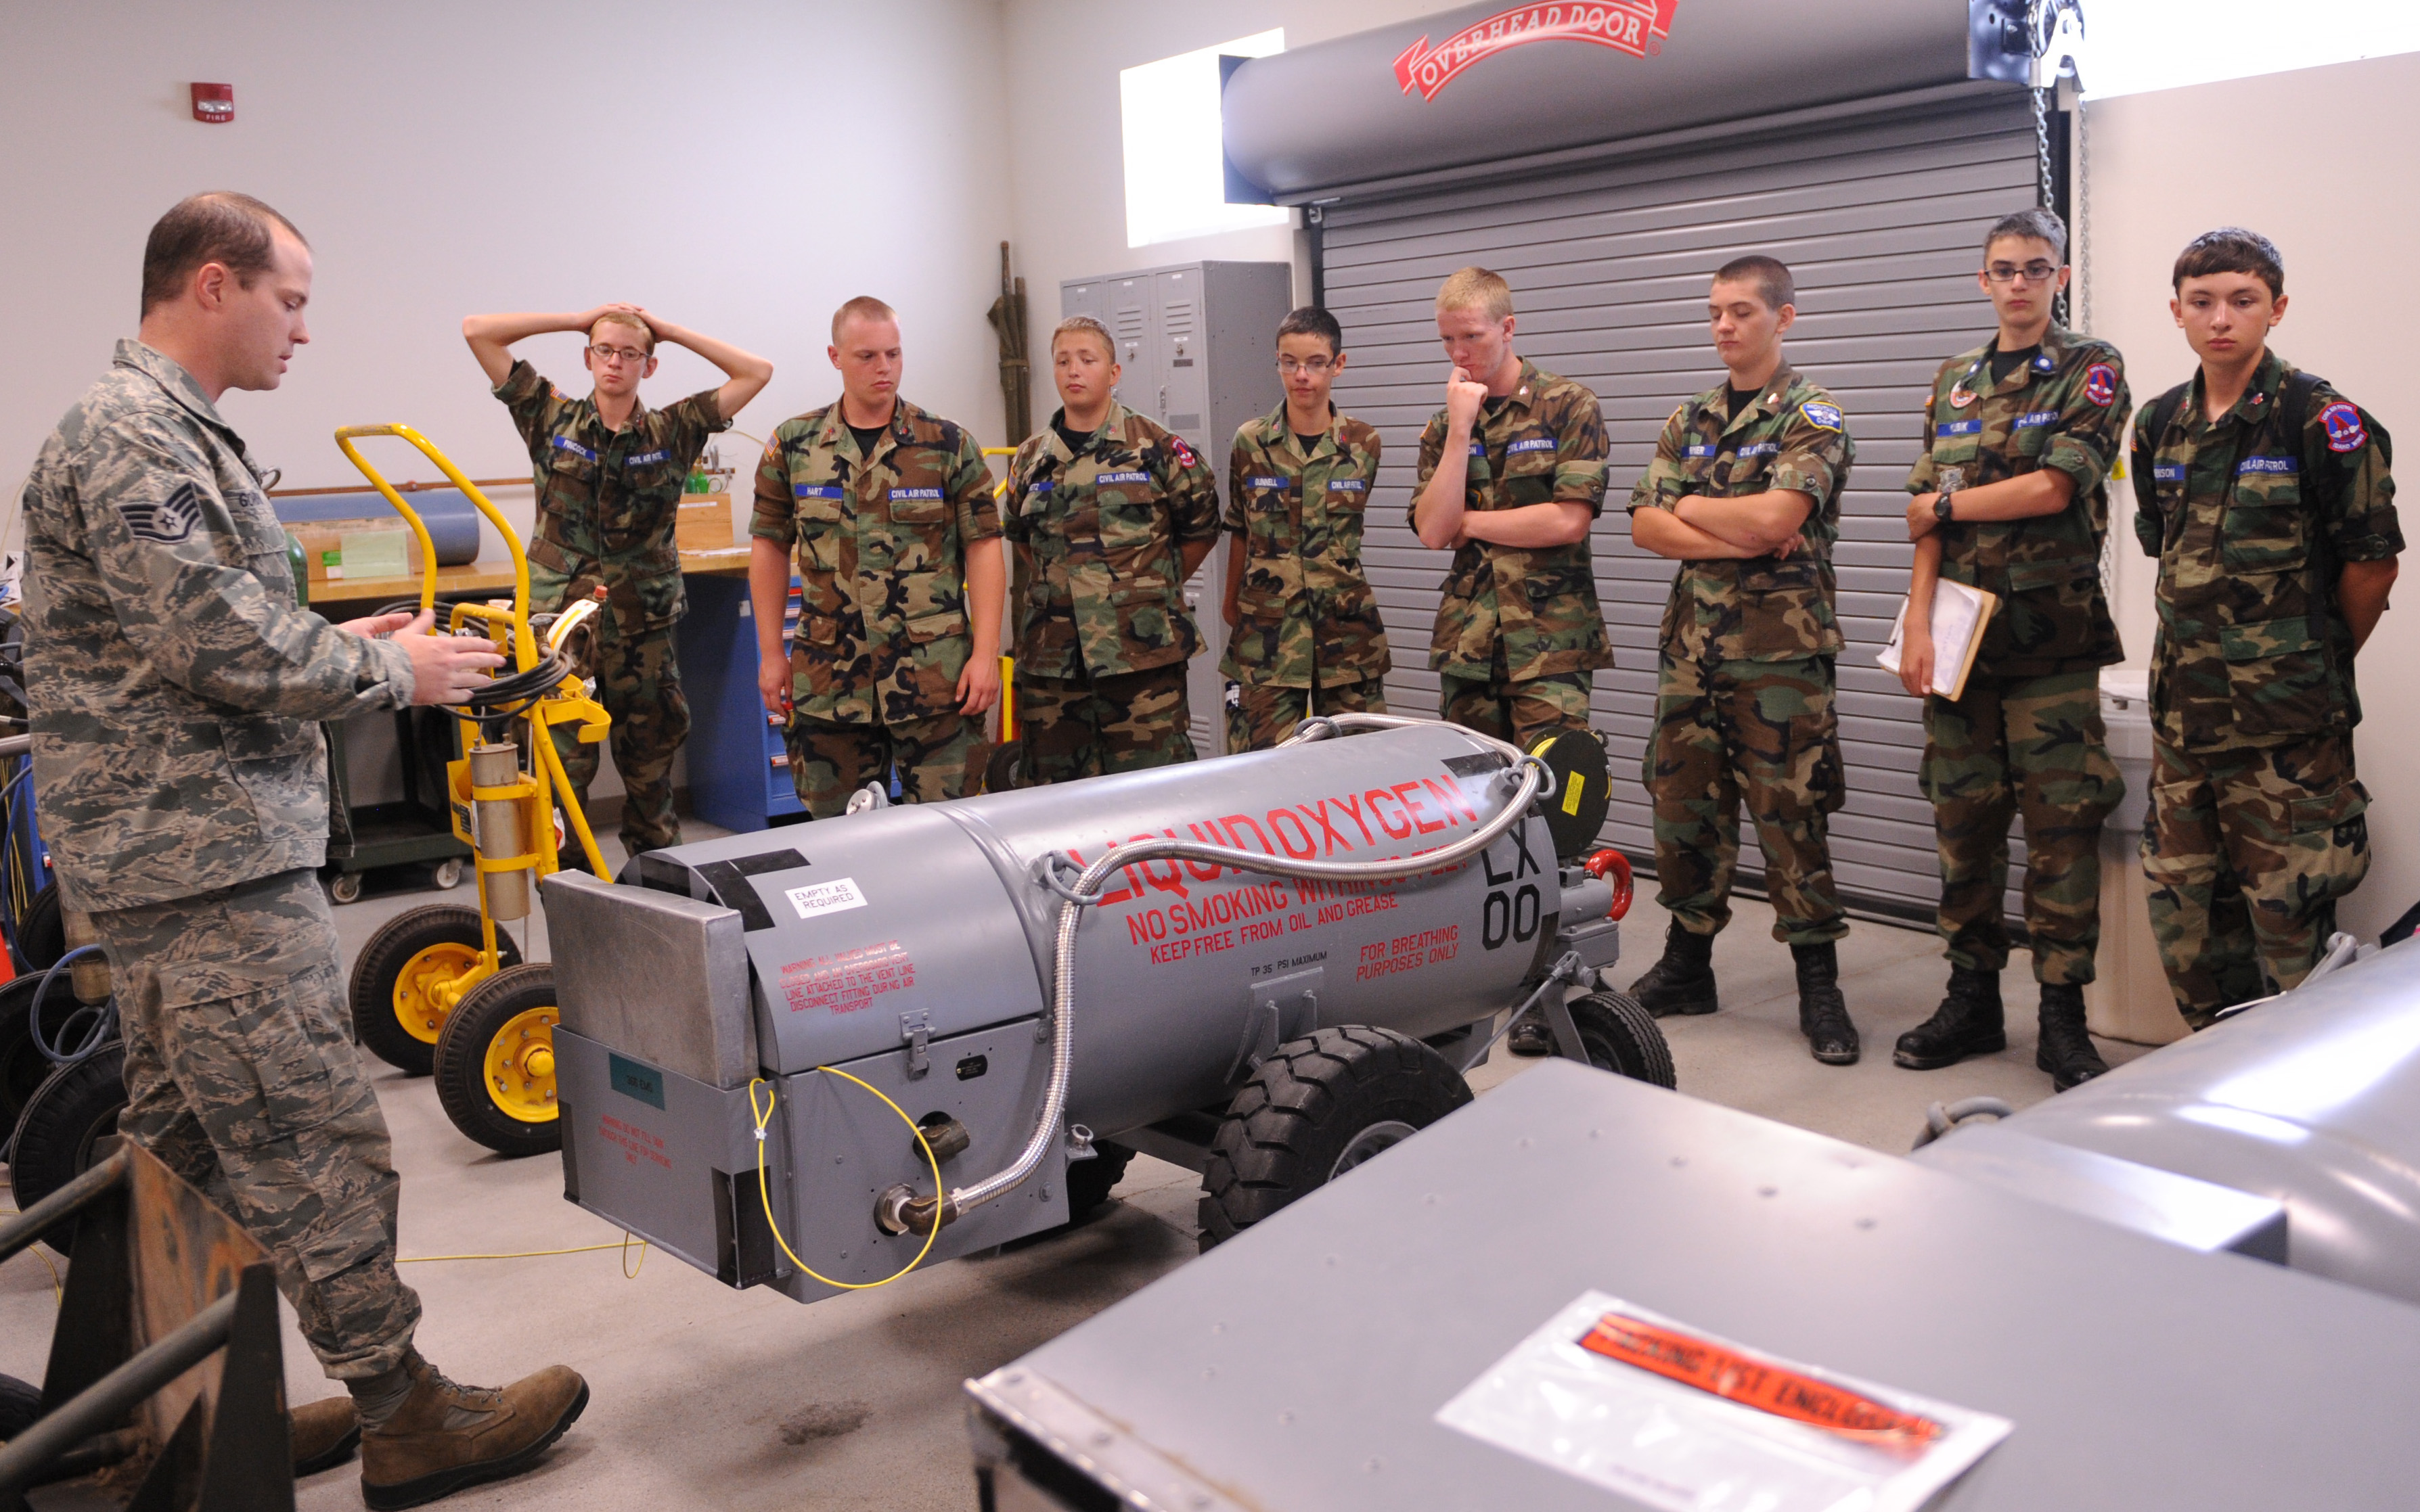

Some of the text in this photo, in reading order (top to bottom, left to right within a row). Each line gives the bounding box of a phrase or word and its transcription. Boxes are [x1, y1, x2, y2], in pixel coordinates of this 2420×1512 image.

[1421, 5, 1643, 86] OVERHEAD DOOR
[1519, 440, 1529, 451] AIR
[1529, 440, 1554, 449] PATROL
[1098, 472, 1148, 483] CIVIL AIR PATROL
[2251, 459, 2265, 470] AIR
[2265, 460, 2289, 471] PATROL
[807, 486, 824, 496] HART
[891, 488, 940, 499] CIVIL AIR PATROL
[1266, 774, 1478, 861] OXYGEN
[1473, 817, 1542, 887] LX
[794, 884, 848, 901] EMPTY AS
[803, 892, 855, 909] REQUIRED
[1126, 909, 1167, 946] NO
[1168, 880, 1289, 935] SMOKING
[1150, 890, 1399, 965] KEEP FREE FROM OIL AND GREASE
[1360, 924, 1459, 963] FOR BREATHING
[780, 957, 816, 974] WARNING
[1250, 950, 1328, 976] TP 35 PSI MAXIMUM
[1356, 943, 1459, 982] PURPOSES ONLY
[785, 963, 916, 1001] LINE ATTACHED TO THE VENT LINE
[790, 992, 839, 1012] DISCONNECT
[841, 985, 871, 1001] FITTING
[902, 976, 915, 988] AIR
[829, 996, 873, 1015] TRANSPORT
